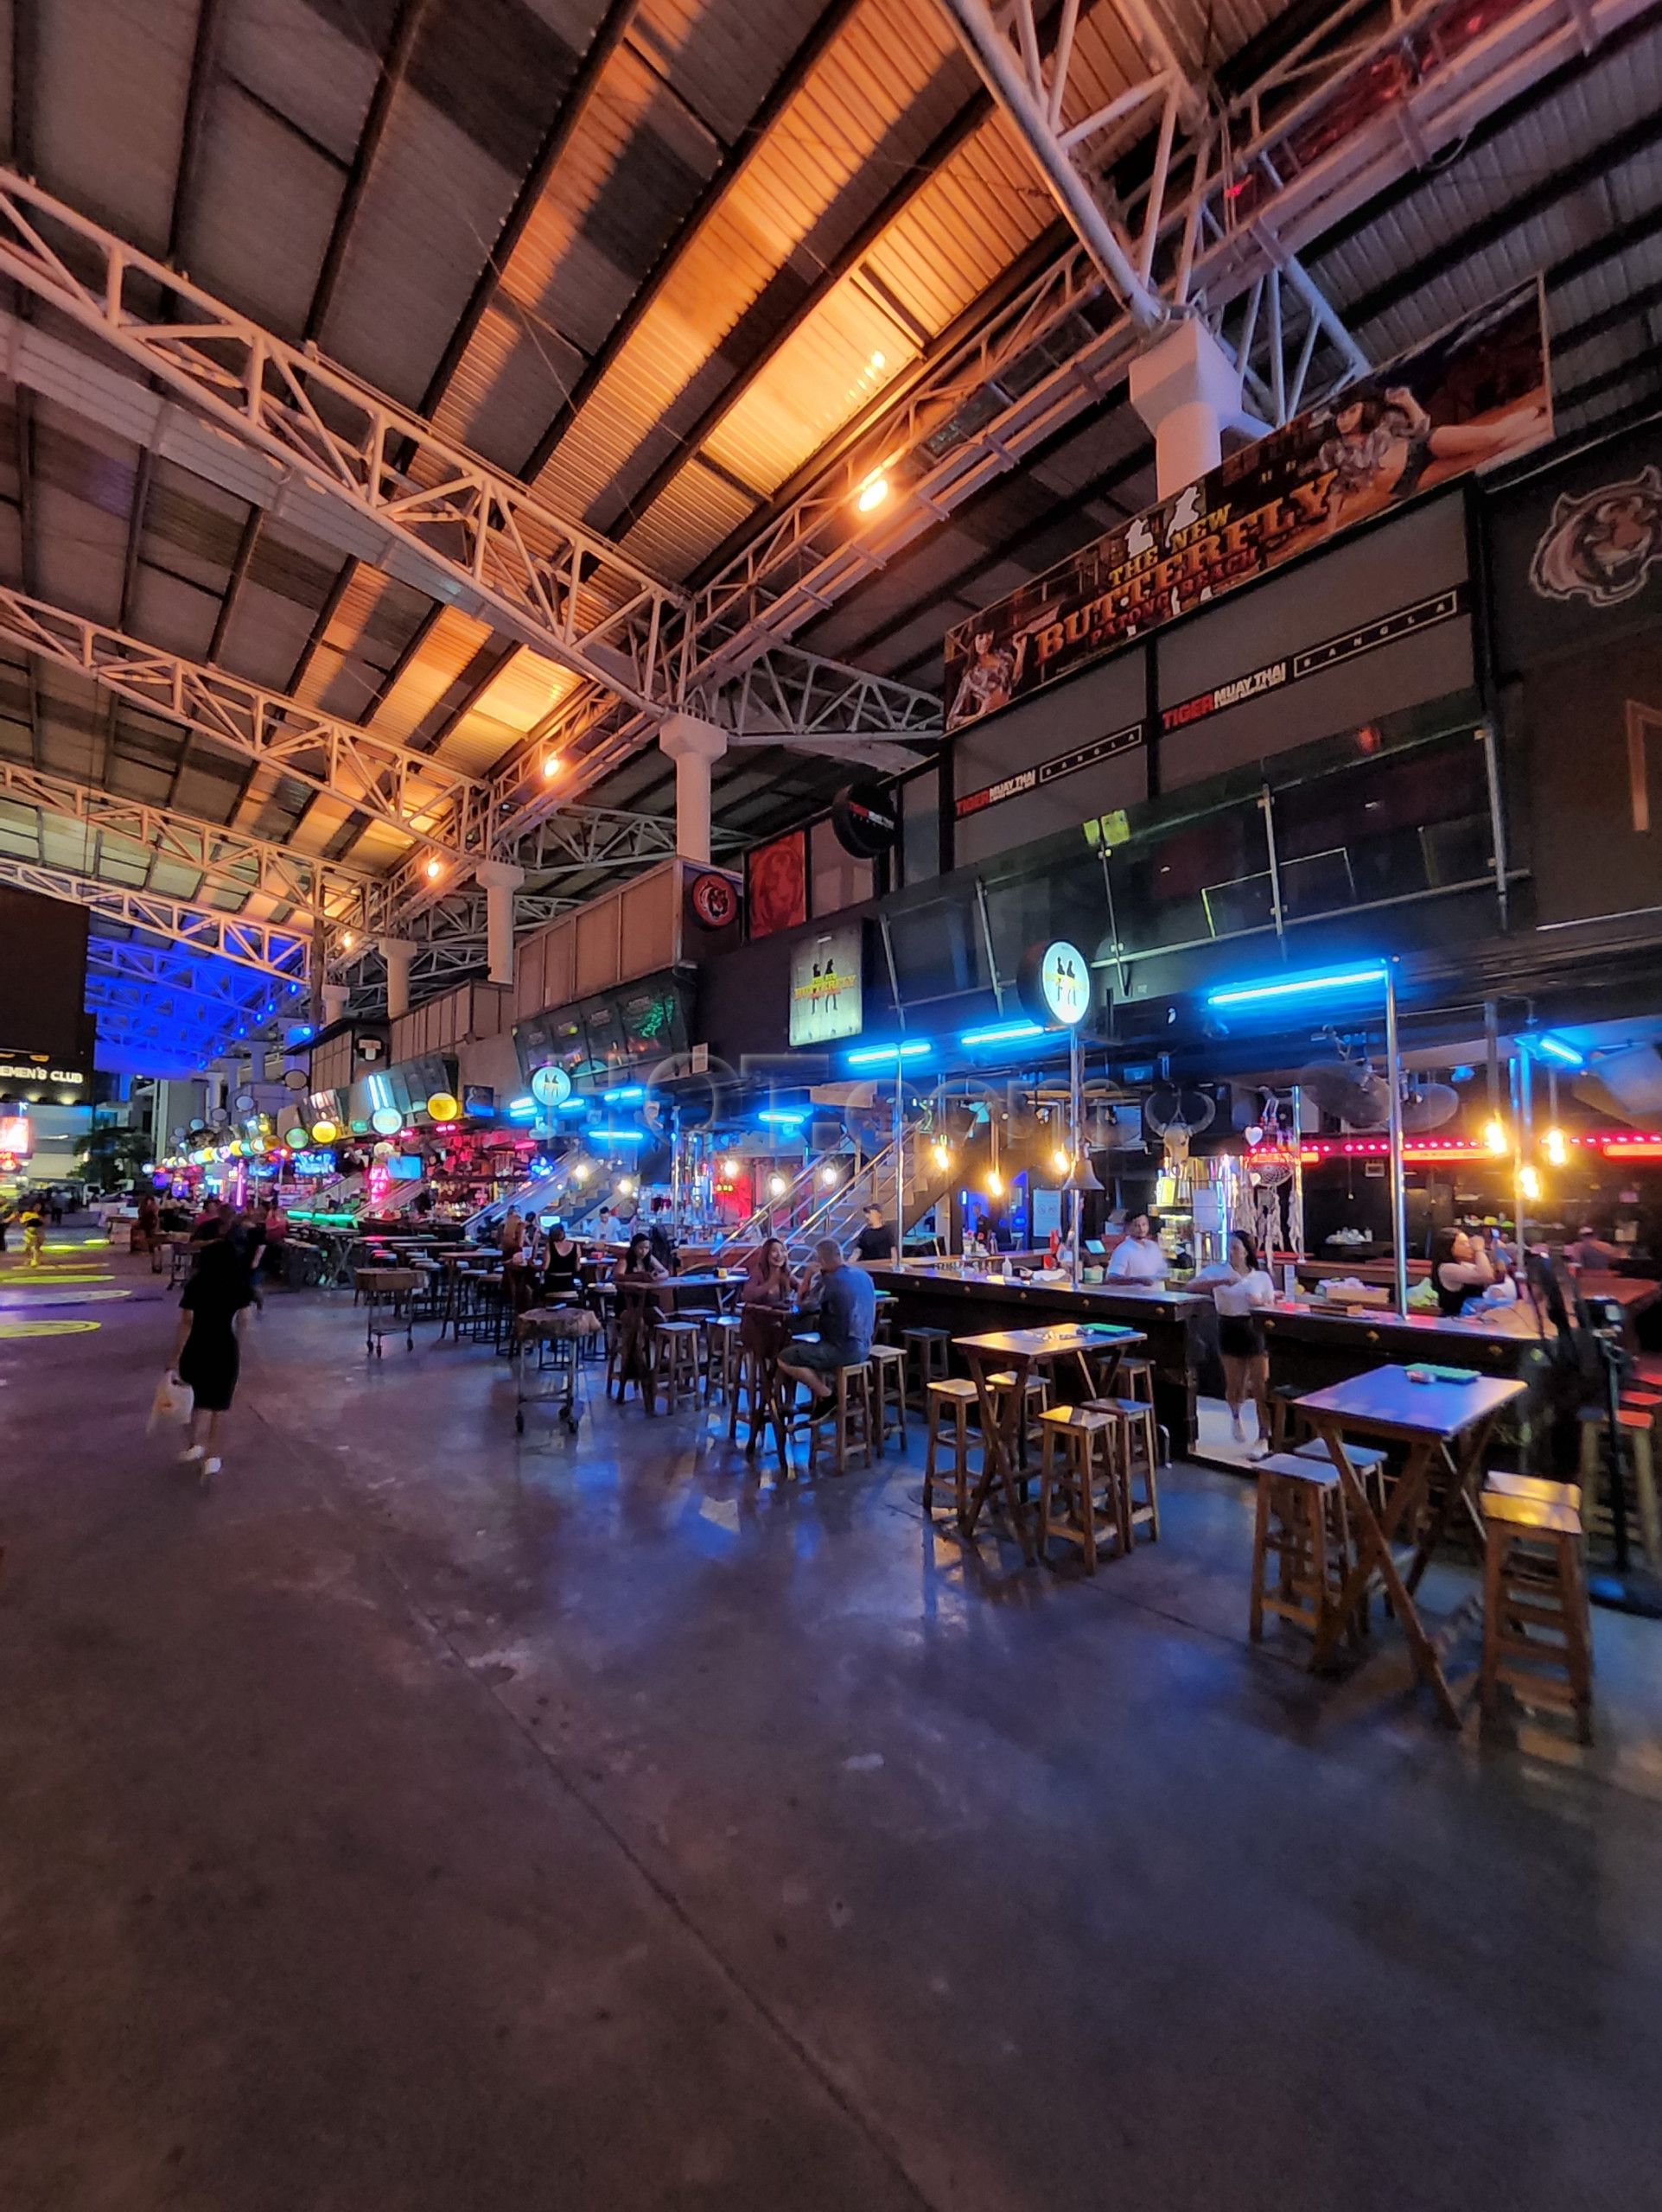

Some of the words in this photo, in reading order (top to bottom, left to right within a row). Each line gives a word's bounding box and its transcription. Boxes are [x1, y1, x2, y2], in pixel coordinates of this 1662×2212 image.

[1035, 468, 1340, 661] BUTTERFLY
[1109, 545, 1159, 588] THE
[1169, 503, 1232, 550] NEW
[1089, 592, 1171, 646] PATONG
[1162, 692, 1214, 730] TIGER
[1213, 677, 1252, 708] MUAY
[1253, 662, 1287, 689] THAI
[50, 1071, 83, 1083] CLUB
